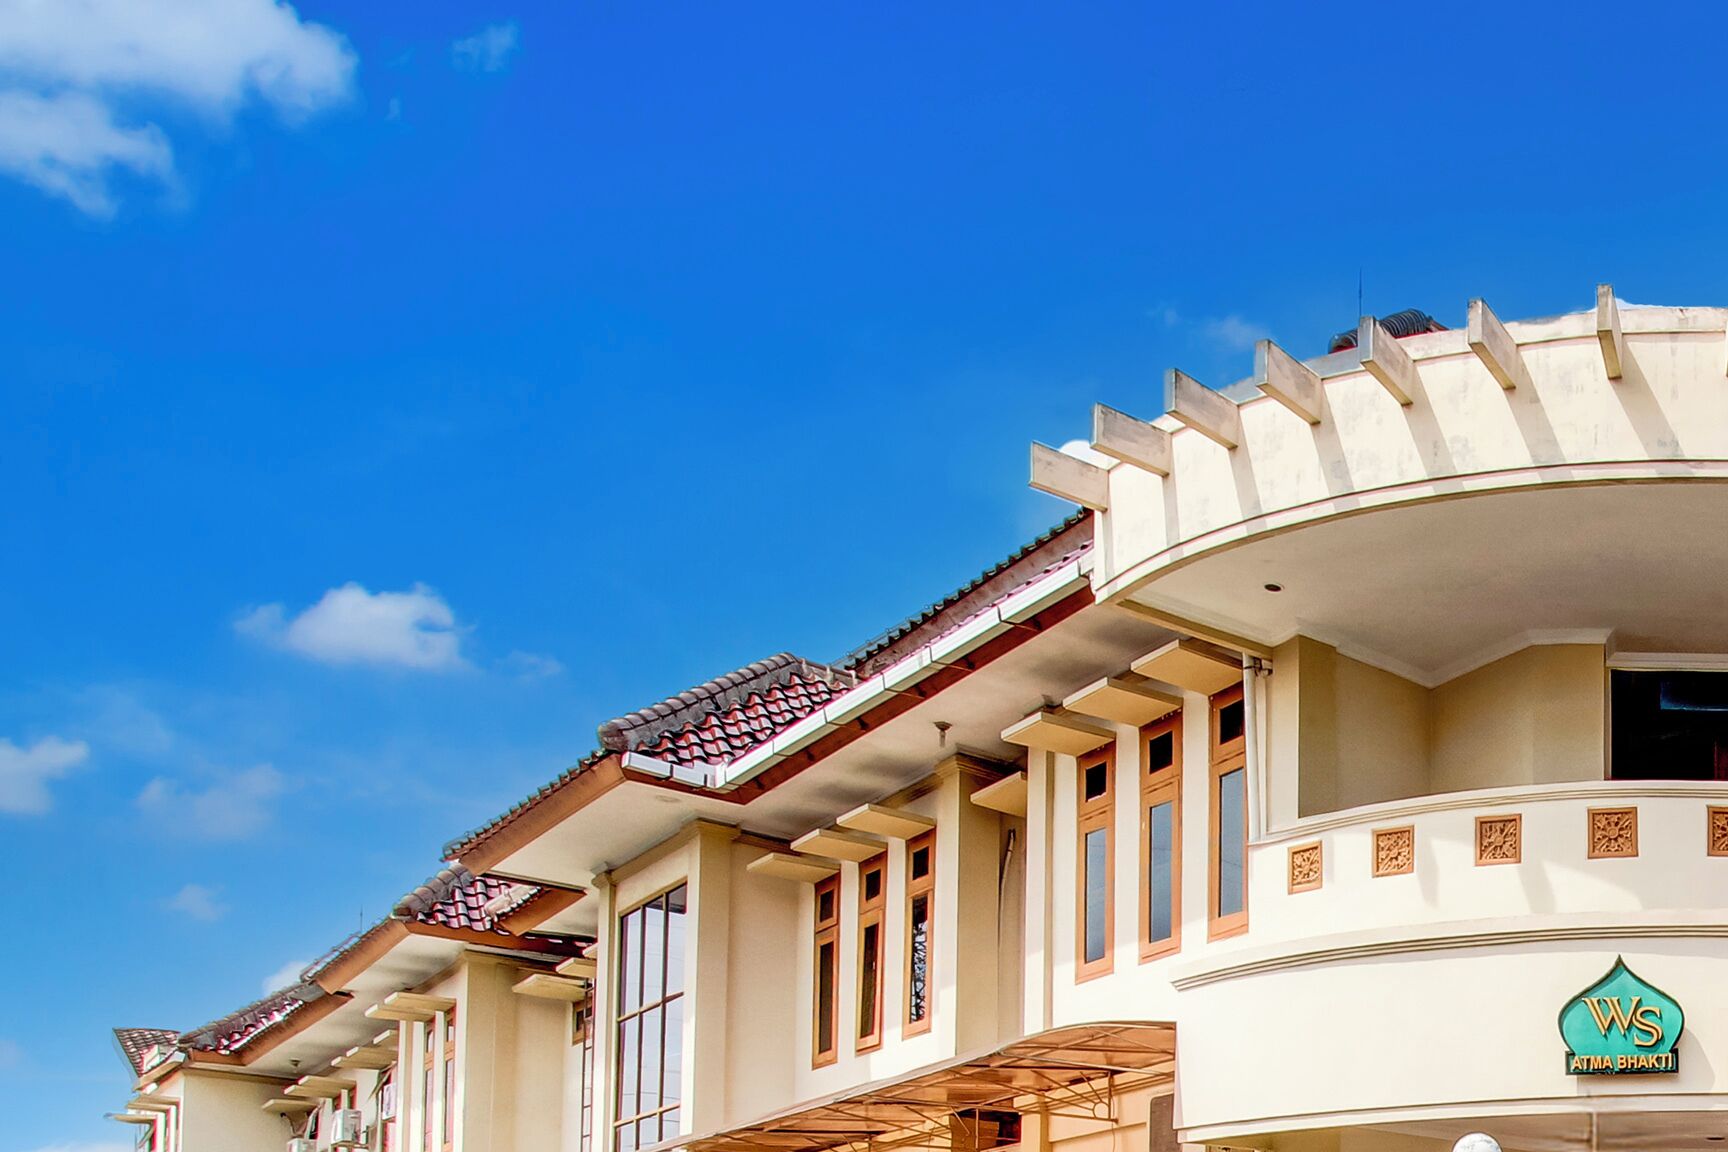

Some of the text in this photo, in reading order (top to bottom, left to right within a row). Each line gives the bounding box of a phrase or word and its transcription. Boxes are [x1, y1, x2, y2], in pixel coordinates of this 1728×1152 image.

[1582, 996, 1662, 1047] WS
[1572, 1053, 1673, 1070] ATMA BHAKTI
